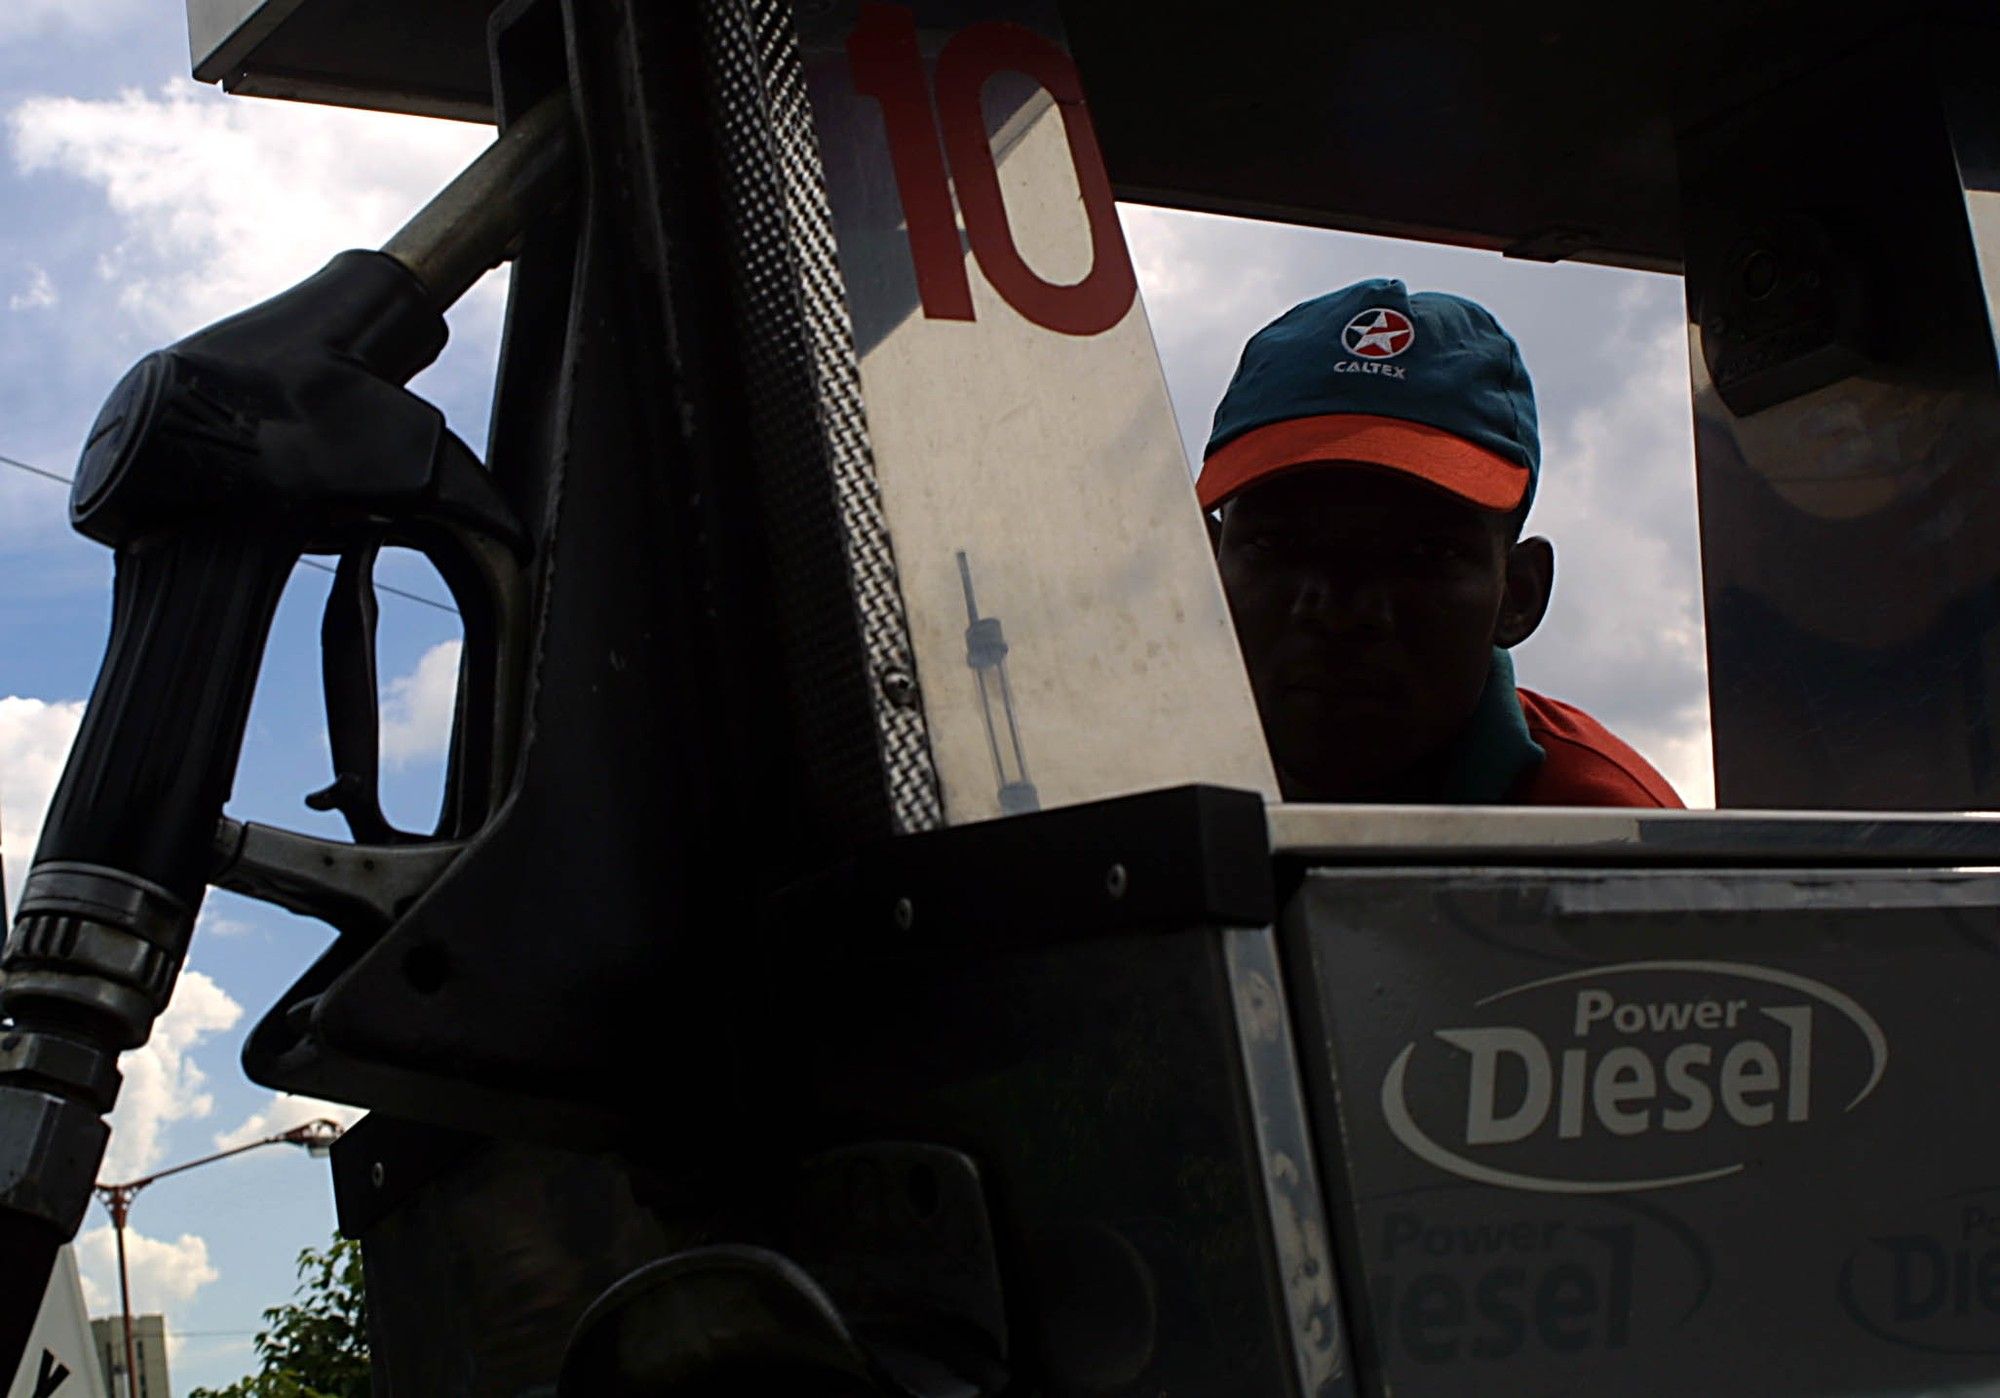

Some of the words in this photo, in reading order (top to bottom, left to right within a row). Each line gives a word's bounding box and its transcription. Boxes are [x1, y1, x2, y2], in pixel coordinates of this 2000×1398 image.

[846, 4, 1137, 336] 10
[1333, 361, 1407, 380] CALTEX
[1574, 990, 1747, 1036] Power
[1435, 1005, 1812, 1146] Diesel
